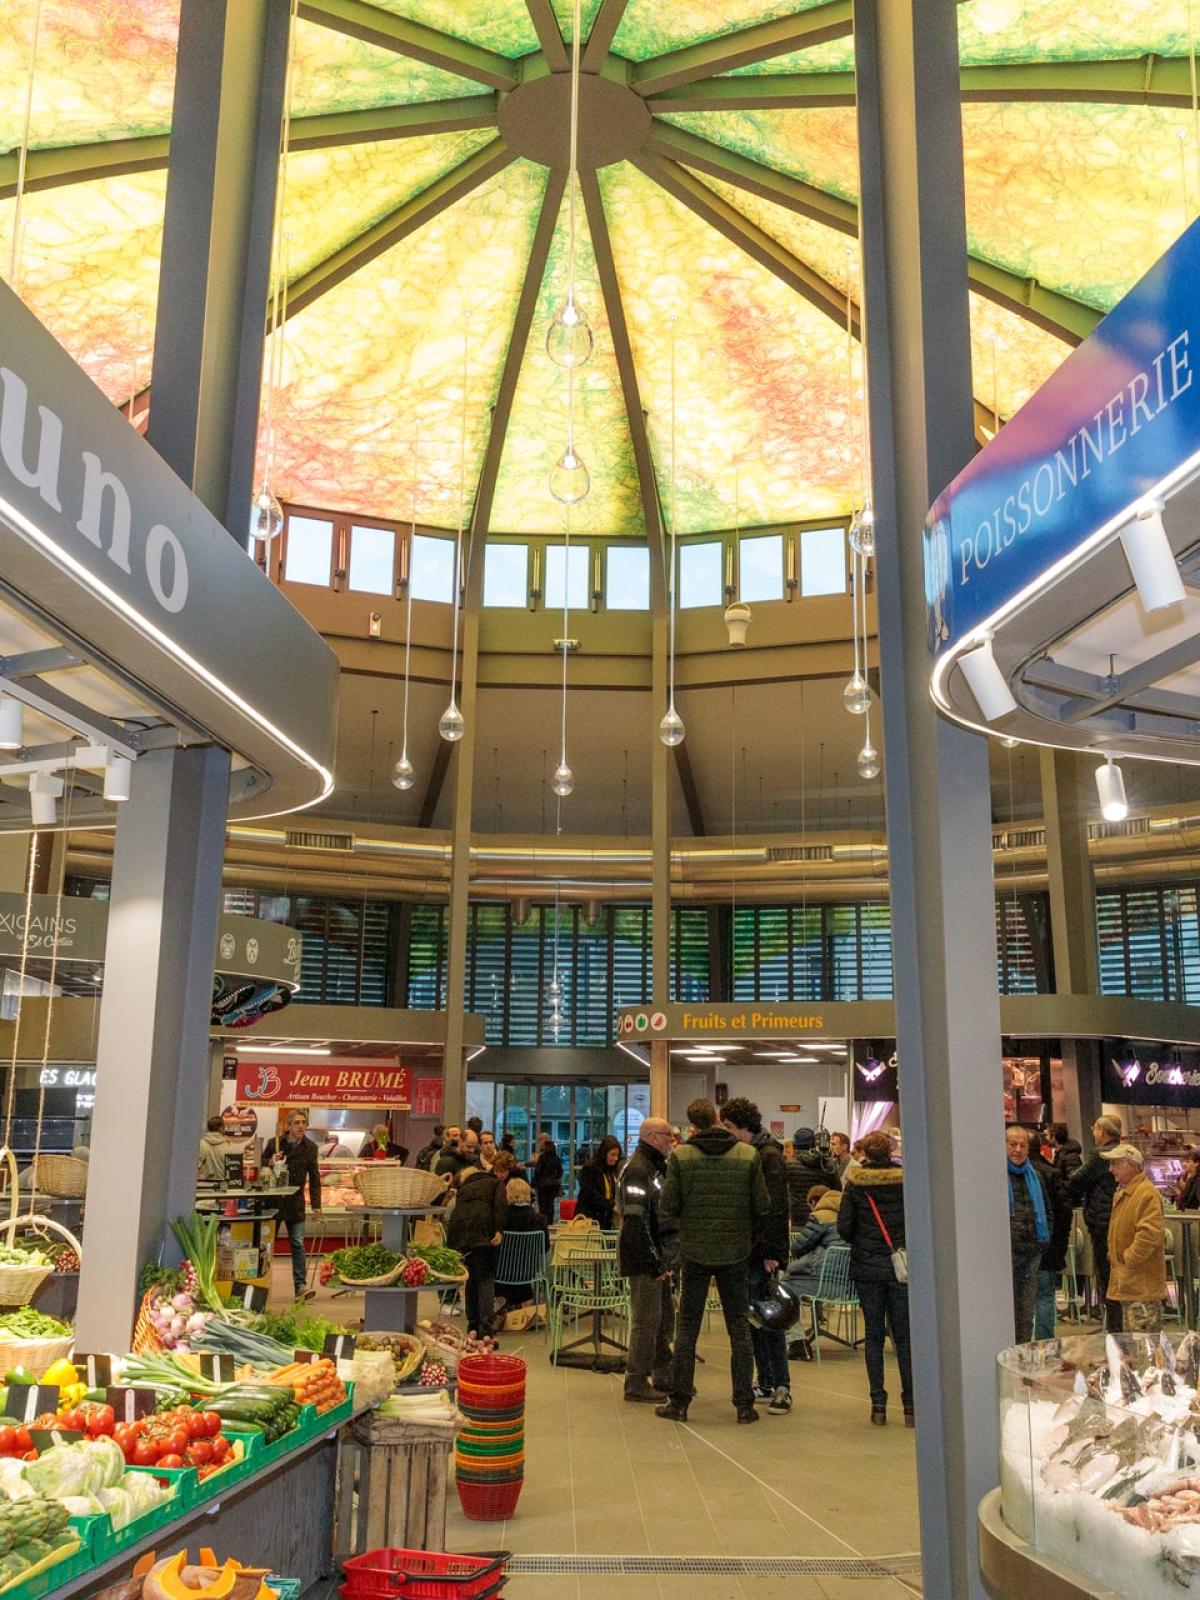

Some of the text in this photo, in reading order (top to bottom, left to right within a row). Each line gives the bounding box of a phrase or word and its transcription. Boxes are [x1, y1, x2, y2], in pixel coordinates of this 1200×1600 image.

[960, 330, 1193, 586] POISSONNERIE
[683, 1013, 823, 1029] Fruits et Primeurs
[290, 1068, 406, 1089] Jean BRUMÉ
[287, 1092, 310, 1101] Artisan
[311, 1092, 336, 1101] Boucher
[342, 1093, 378, 1102] Charcuterie
[383, 1094, 408, 1102] Volailles
